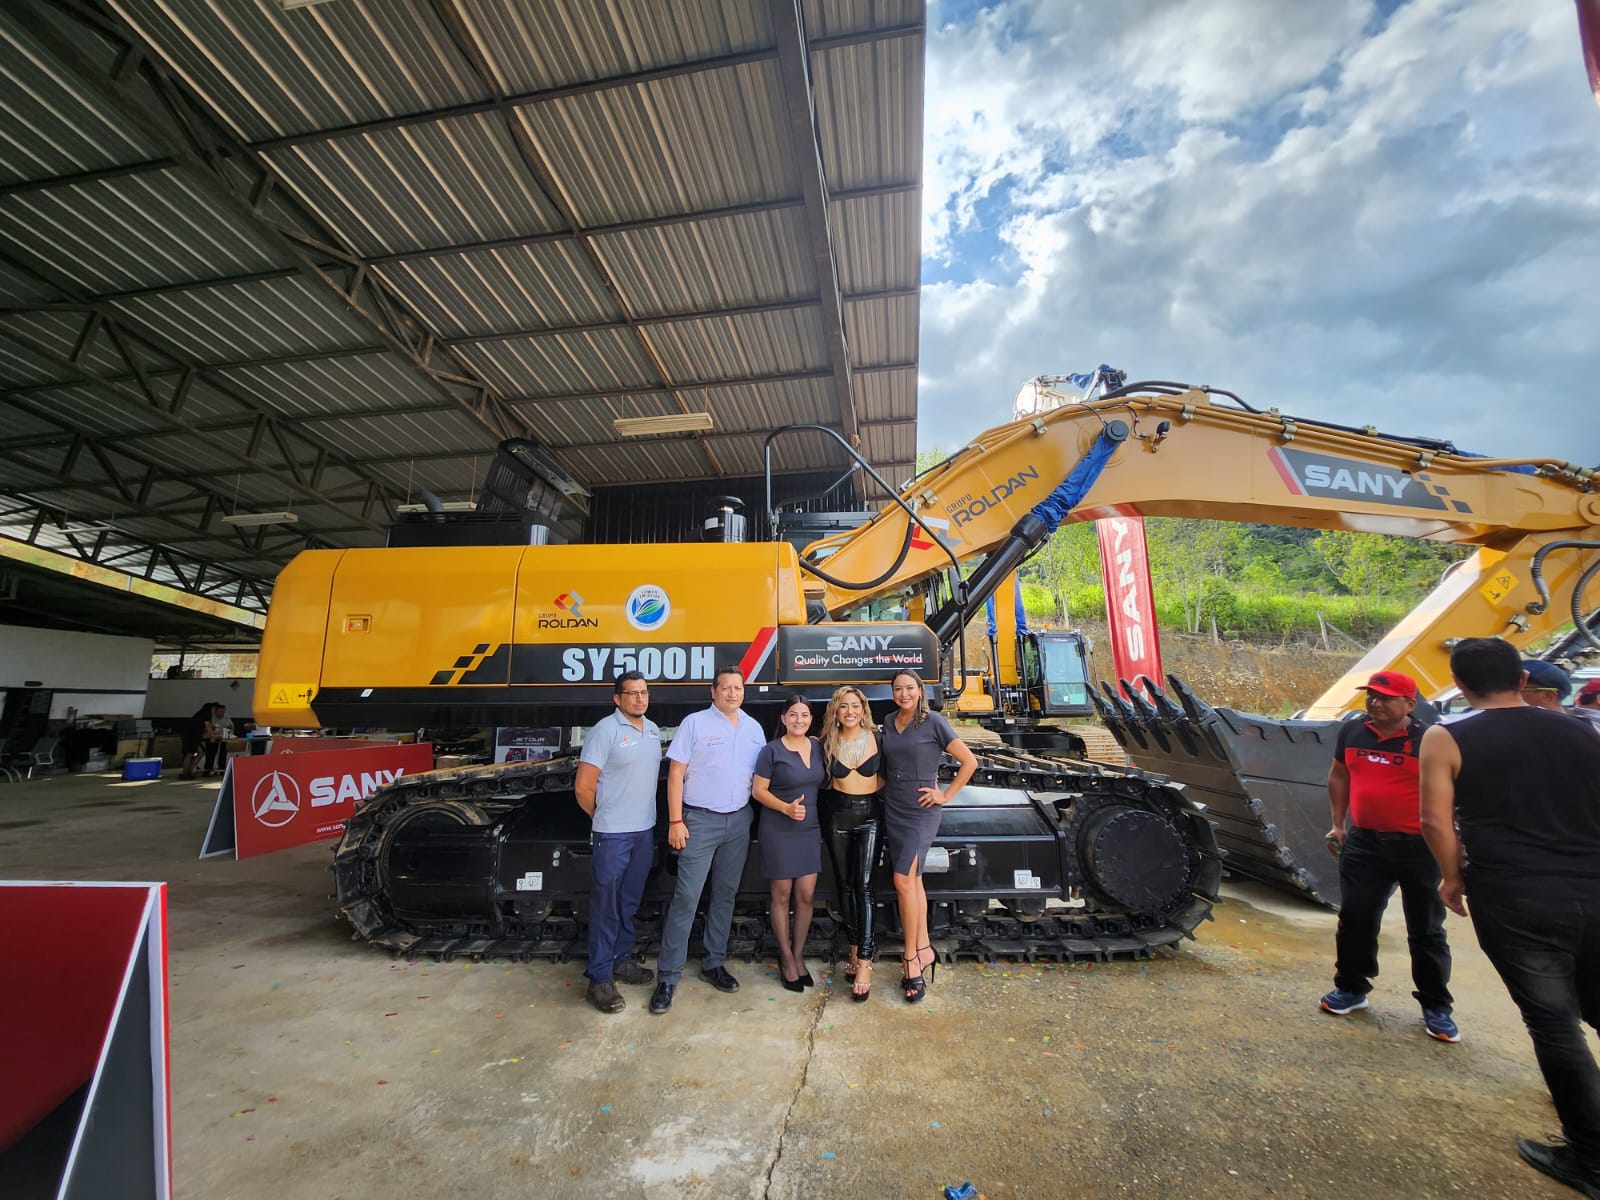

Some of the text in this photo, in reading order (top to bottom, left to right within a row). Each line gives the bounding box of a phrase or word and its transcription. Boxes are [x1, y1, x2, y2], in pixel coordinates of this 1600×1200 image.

[1305, 465, 1411, 498] SANY
[946, 494, 972, 513] GRUPO
[952, 465, 1039, 528] ROLDAN
[1111, 518, 1145, 661] SANY
[538, 618, 598, 629] ROLDAN
[826, 636, 893, 650] SANY
[562, 647, 715, 681] SY500H
[794, 653, 922, 667] Quality Changes the World
[1356, 751, 1404, 766] POLO
[309, 768, 404, 807] SANY
